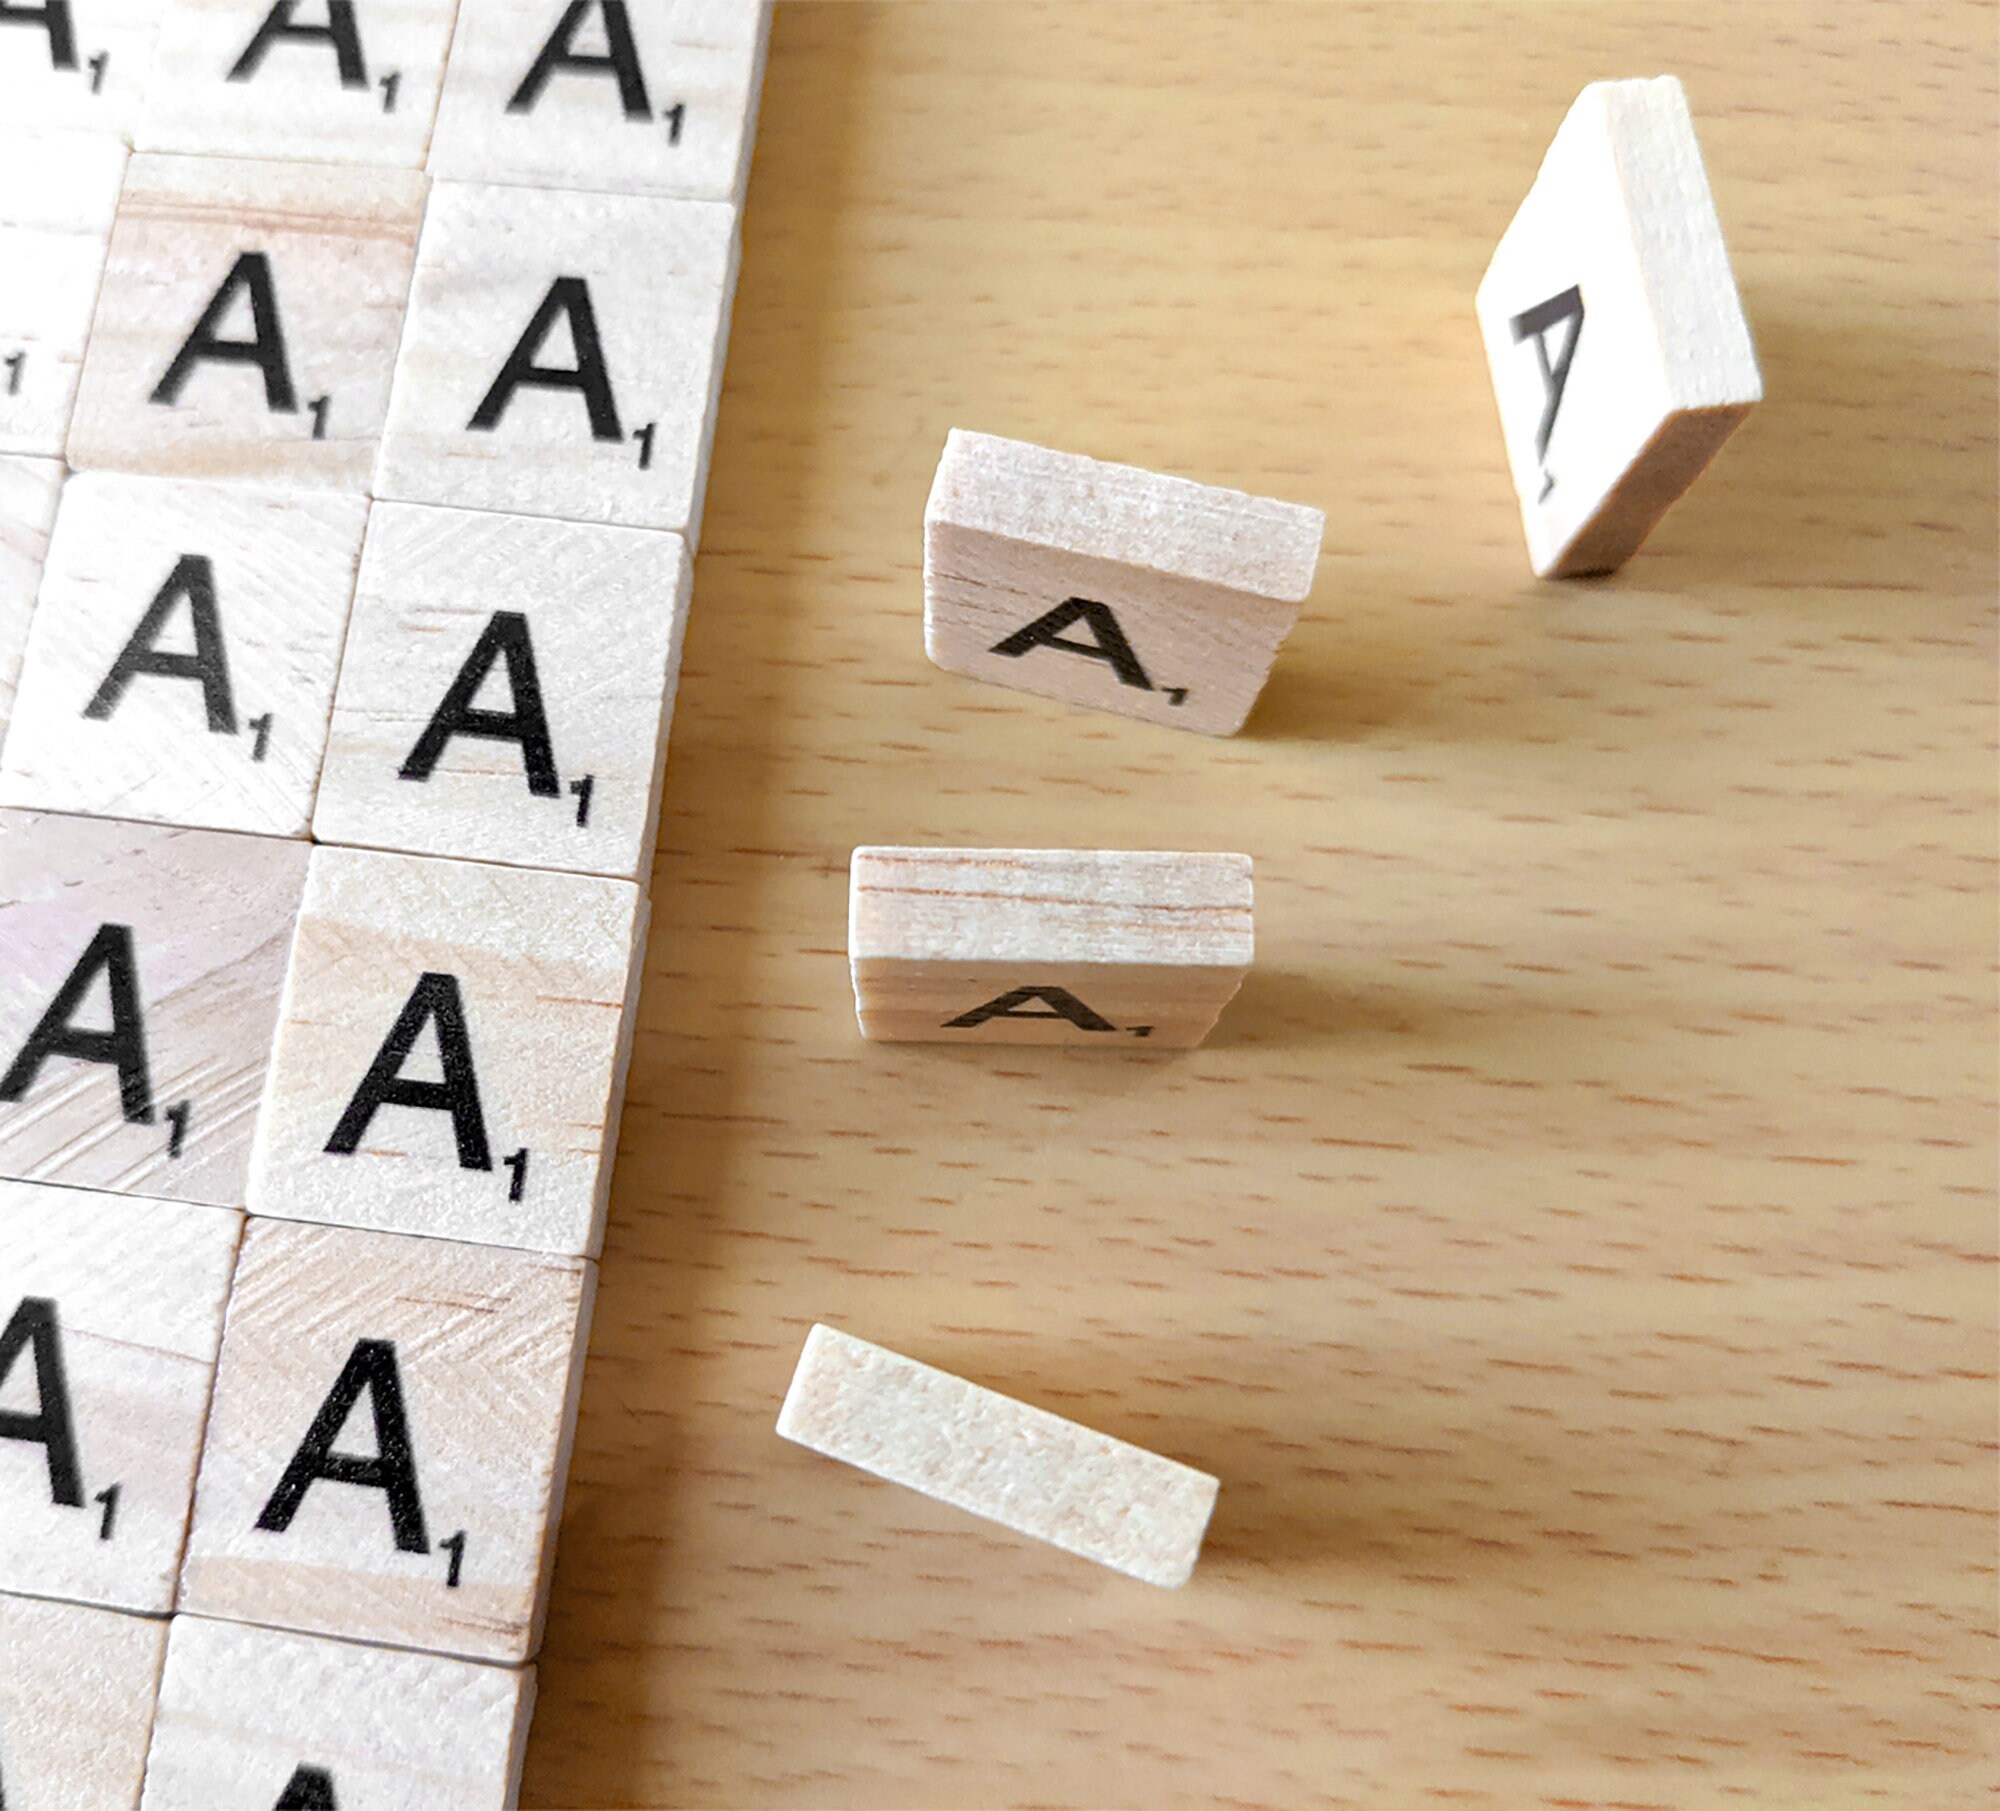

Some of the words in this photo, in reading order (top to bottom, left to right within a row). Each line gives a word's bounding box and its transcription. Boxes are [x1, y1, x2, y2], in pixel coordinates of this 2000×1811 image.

[379, 72, 400, 112] 1
[663, 103, 686, 146] 1
[151, 252, 296, 412] A
[308, 396, 328, 438] 1
[467, 276, 623, 442] A
[633, 423, 655, 469] 1
[84, 555, 237, 734] A
[250, 714, 270, 760] 1
[399, 611, 560, 798] A
[571, 775, 594, 827] 1
[989, 597, 1154, 690] A
[0, 924, 154, 1125] A
[165, 1101, 188, 1158] 1
[323, 972, 492, 1172] A
[504, 1148, 528, 1202] 1
[940, 986, 1120, 1032] A
[95, 1485, 120, 1540] 1
[254, 1339, 430, 1554] A
[440, 1531, 465, 1588] 1
